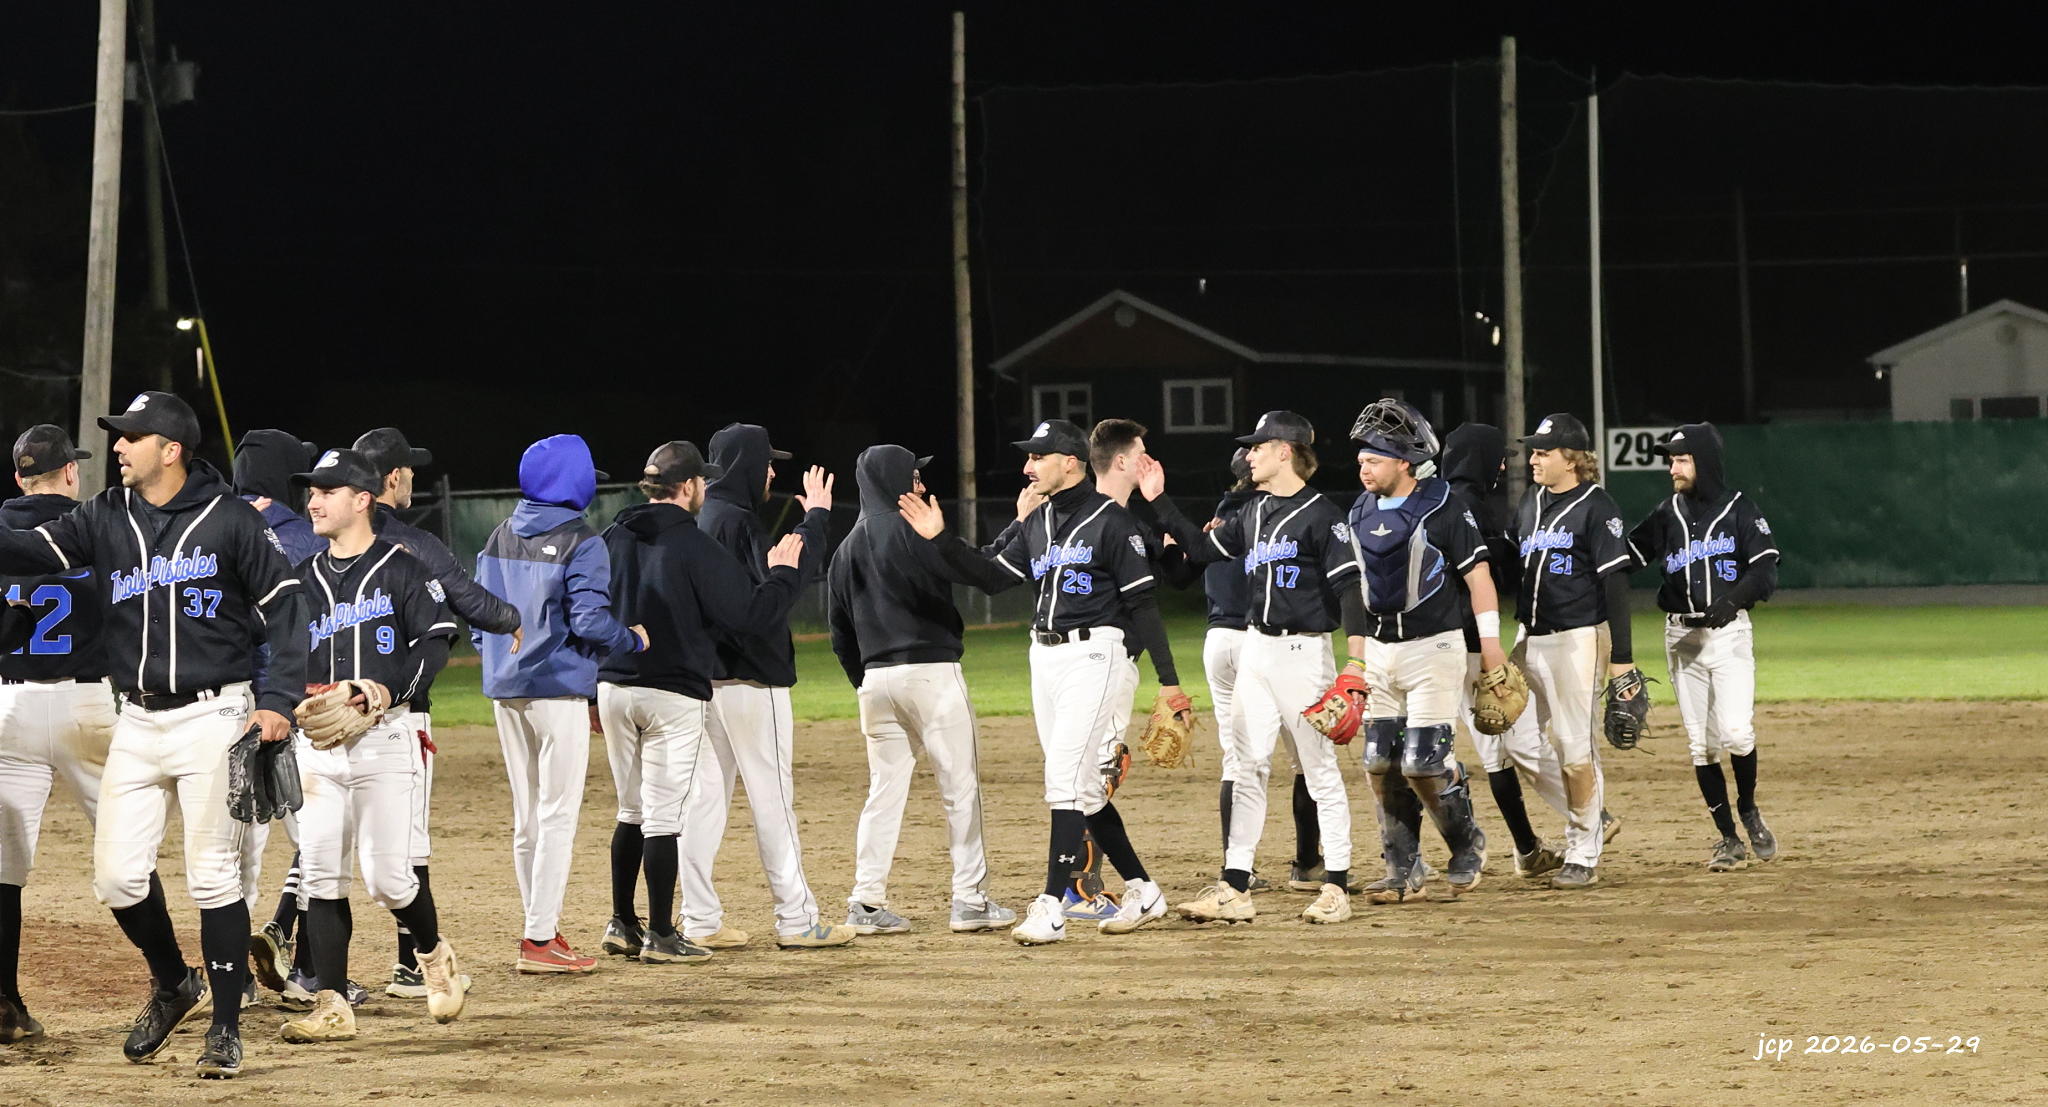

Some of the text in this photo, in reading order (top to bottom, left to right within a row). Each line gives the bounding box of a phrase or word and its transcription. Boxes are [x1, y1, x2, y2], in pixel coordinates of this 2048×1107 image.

[1549, 552, 1572, 575] 21
[1715, 559, 1737, 581] 15
[1062, 569, 1092, 594] 29
[1275, 564, 1300, 588] 17
[183, 587, 222, 618] 37
[376, 625, 395, 654] 9
